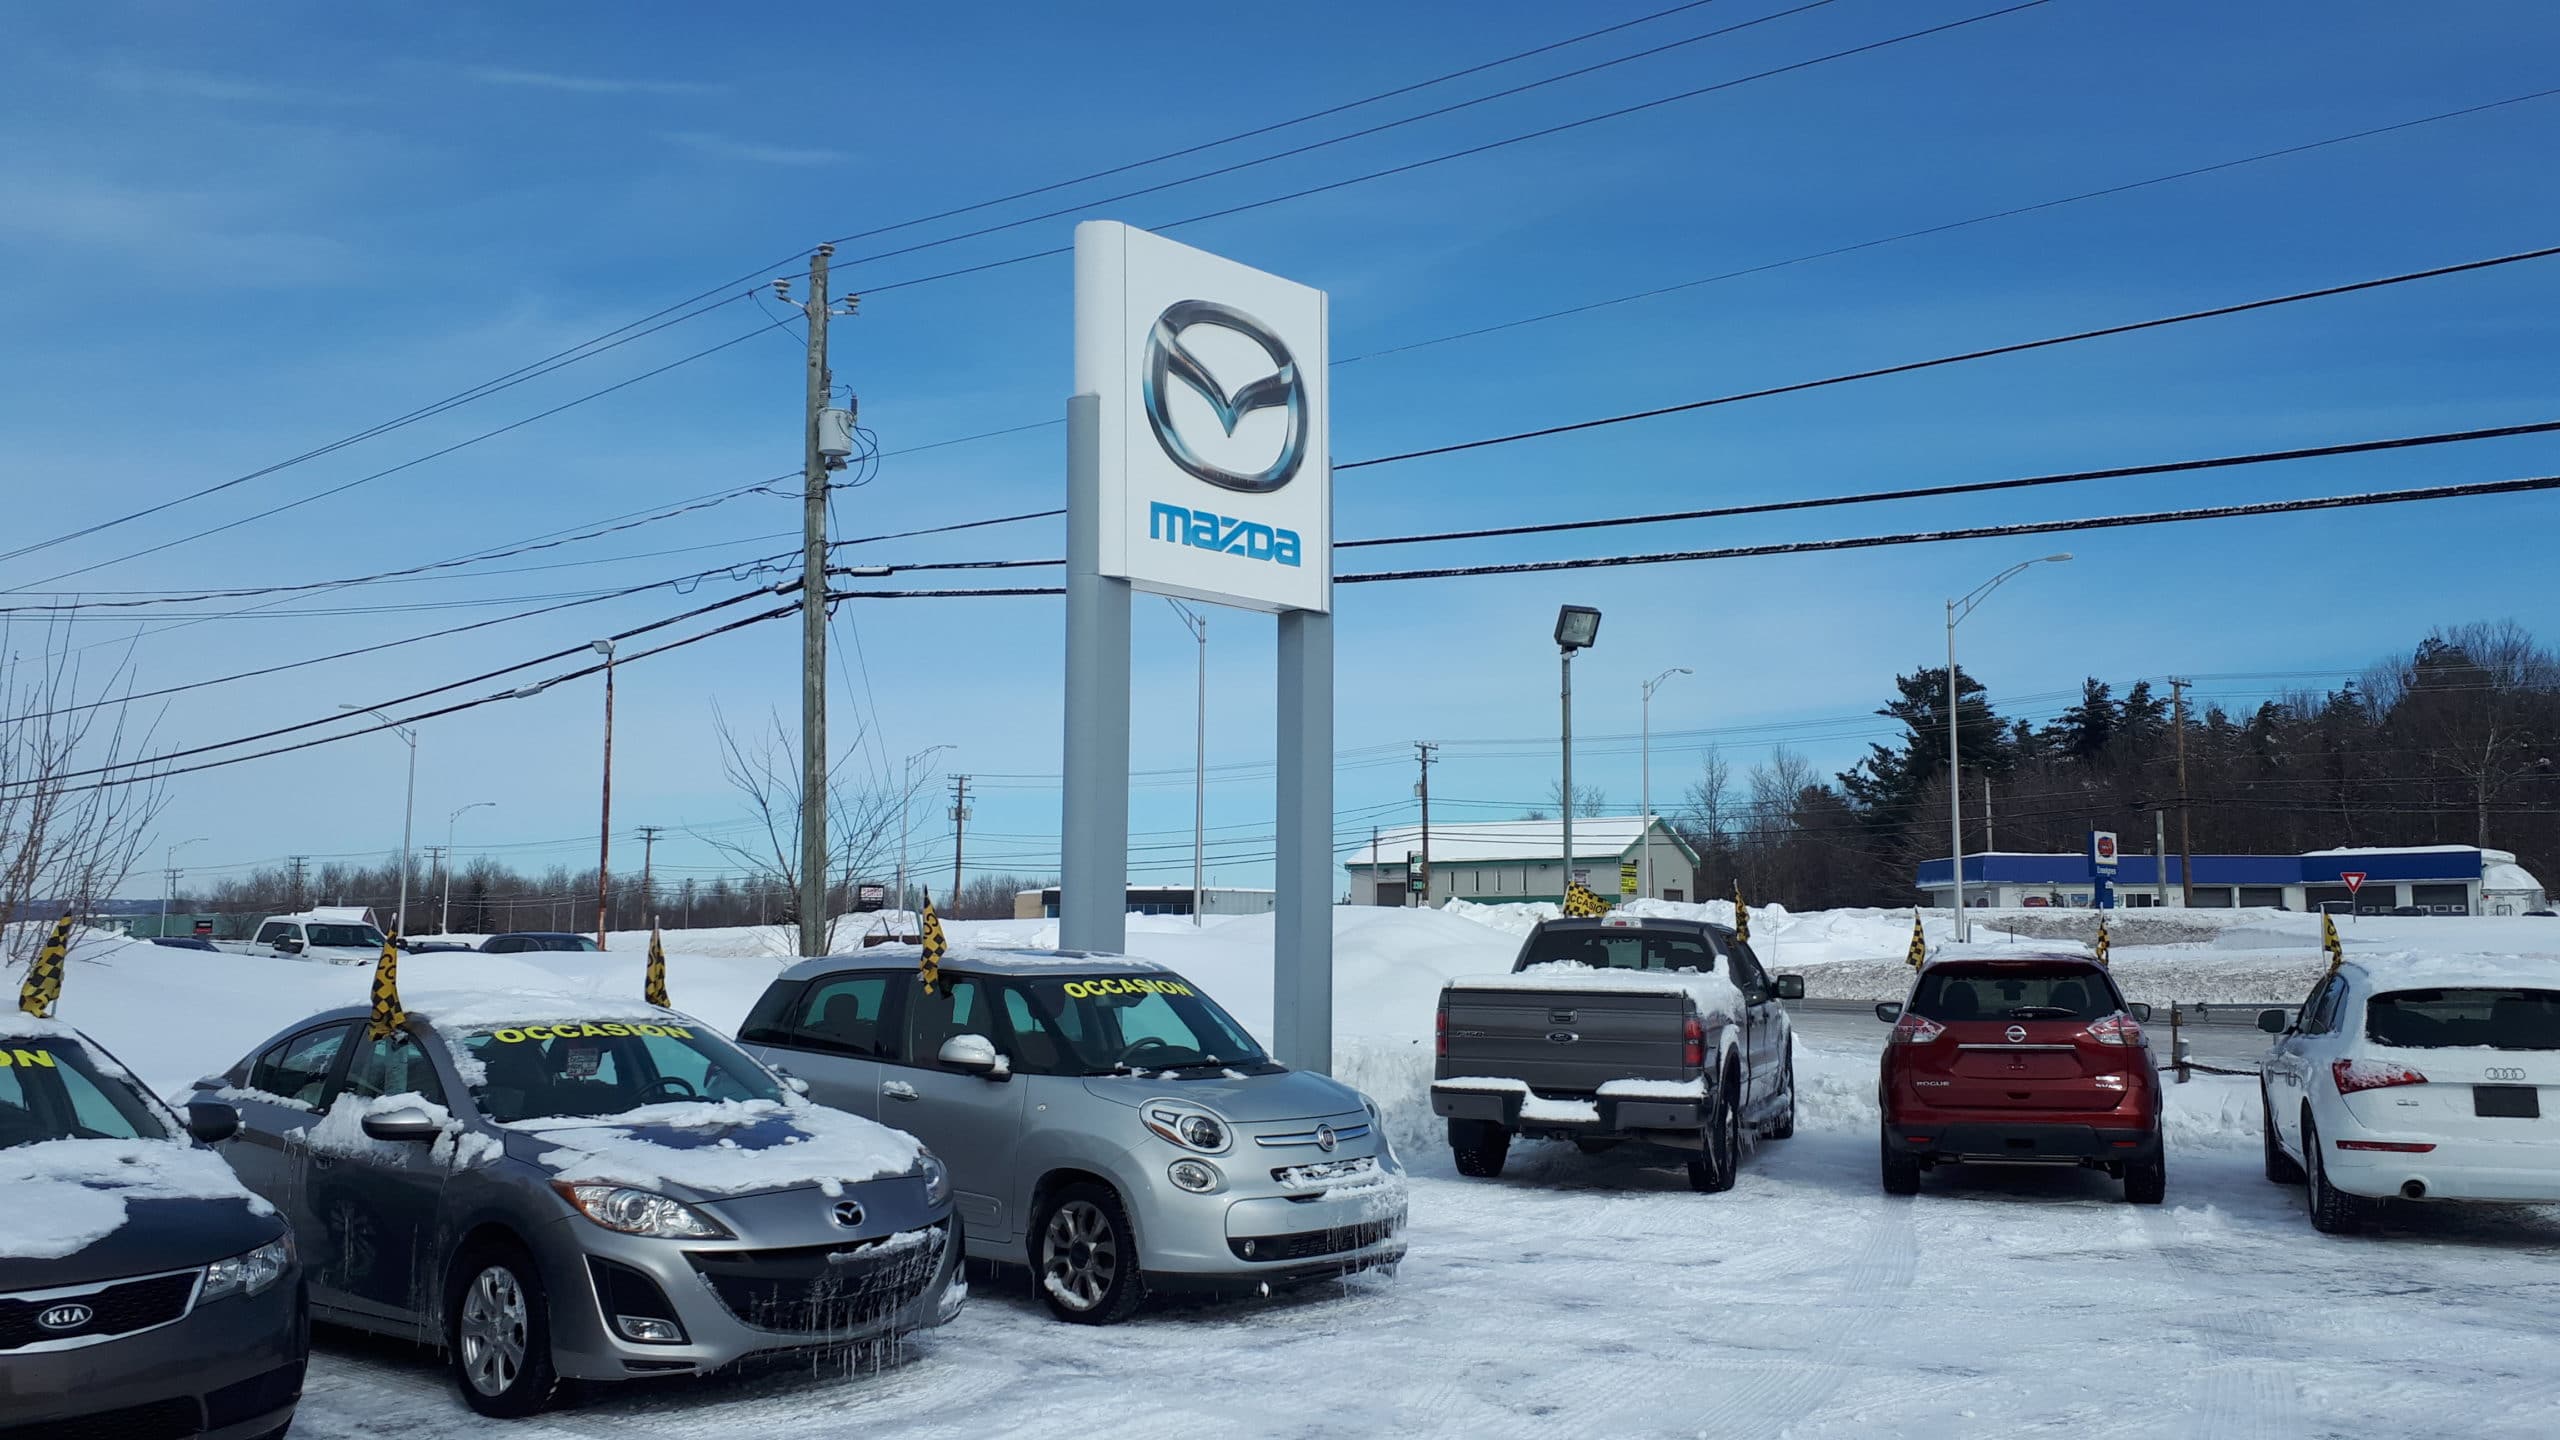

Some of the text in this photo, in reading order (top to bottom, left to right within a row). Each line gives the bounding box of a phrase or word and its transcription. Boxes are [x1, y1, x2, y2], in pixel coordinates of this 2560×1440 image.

[1063, 978, 1195, 998] OCCASION
[494, 1023, 695, 1044] OCCASION
[48, 1308, 85, 1324] KIA
